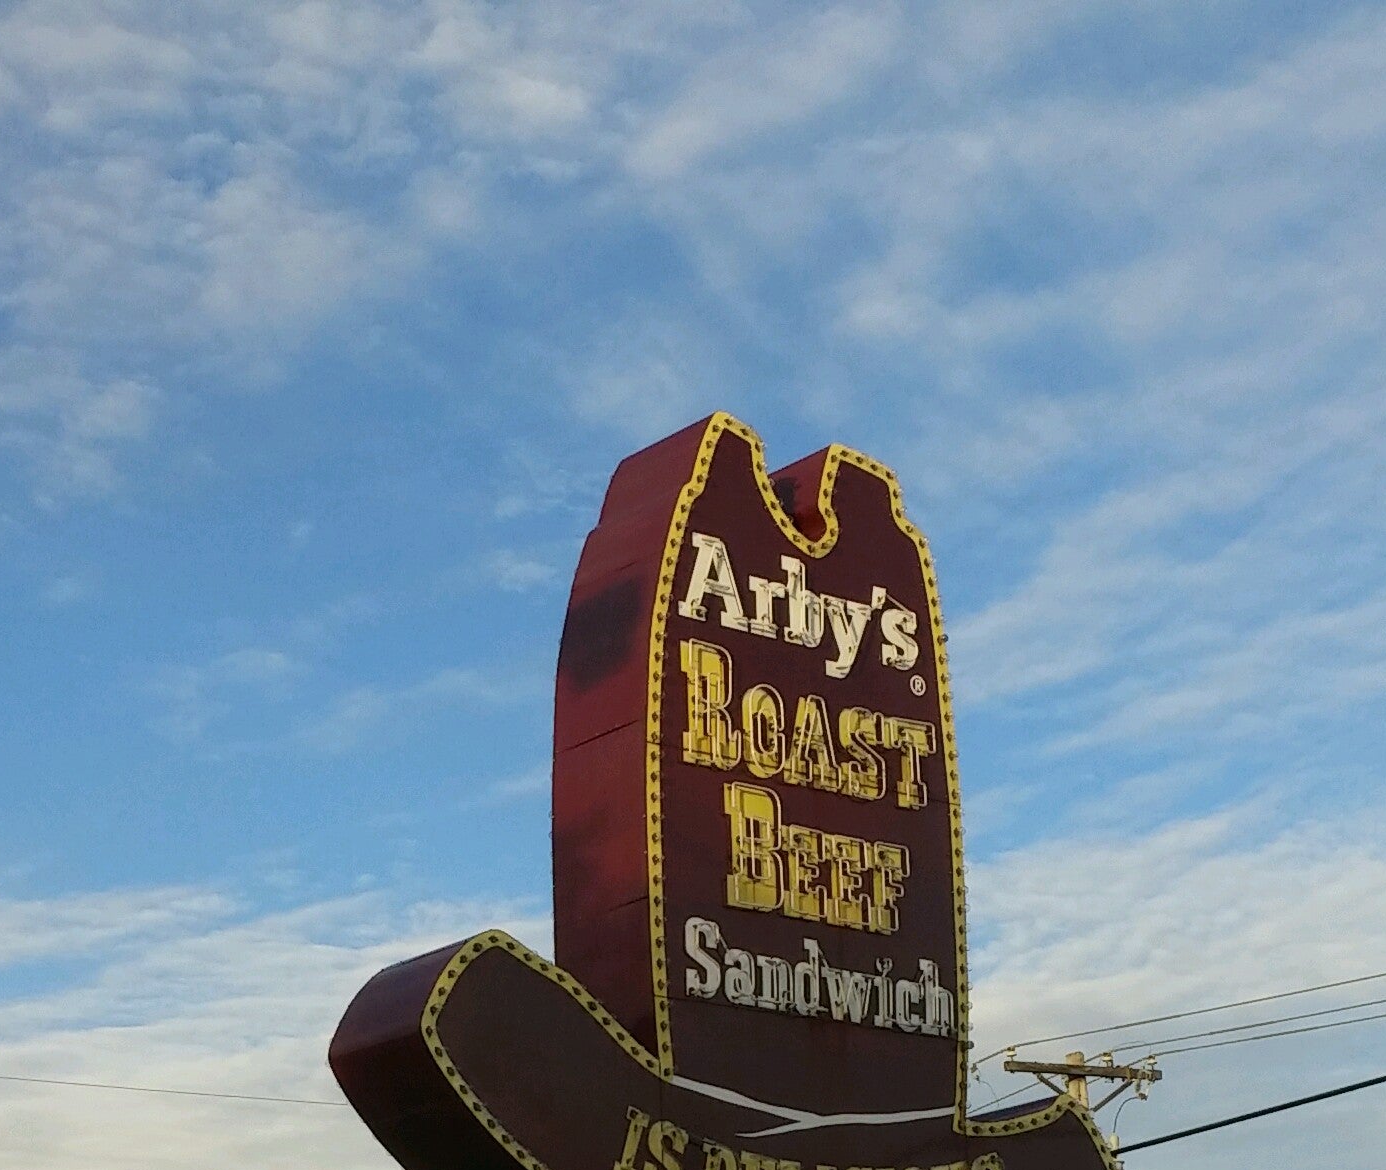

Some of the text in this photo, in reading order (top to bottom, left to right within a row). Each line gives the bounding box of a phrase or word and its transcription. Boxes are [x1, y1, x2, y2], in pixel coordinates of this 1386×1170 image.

[678, 532, 920, 678] Arby's
[680, 639, 936, 810] ROAST
[724, 781, 910, 934] BEEF
[684, 917, 955, 1038] Sandwich
